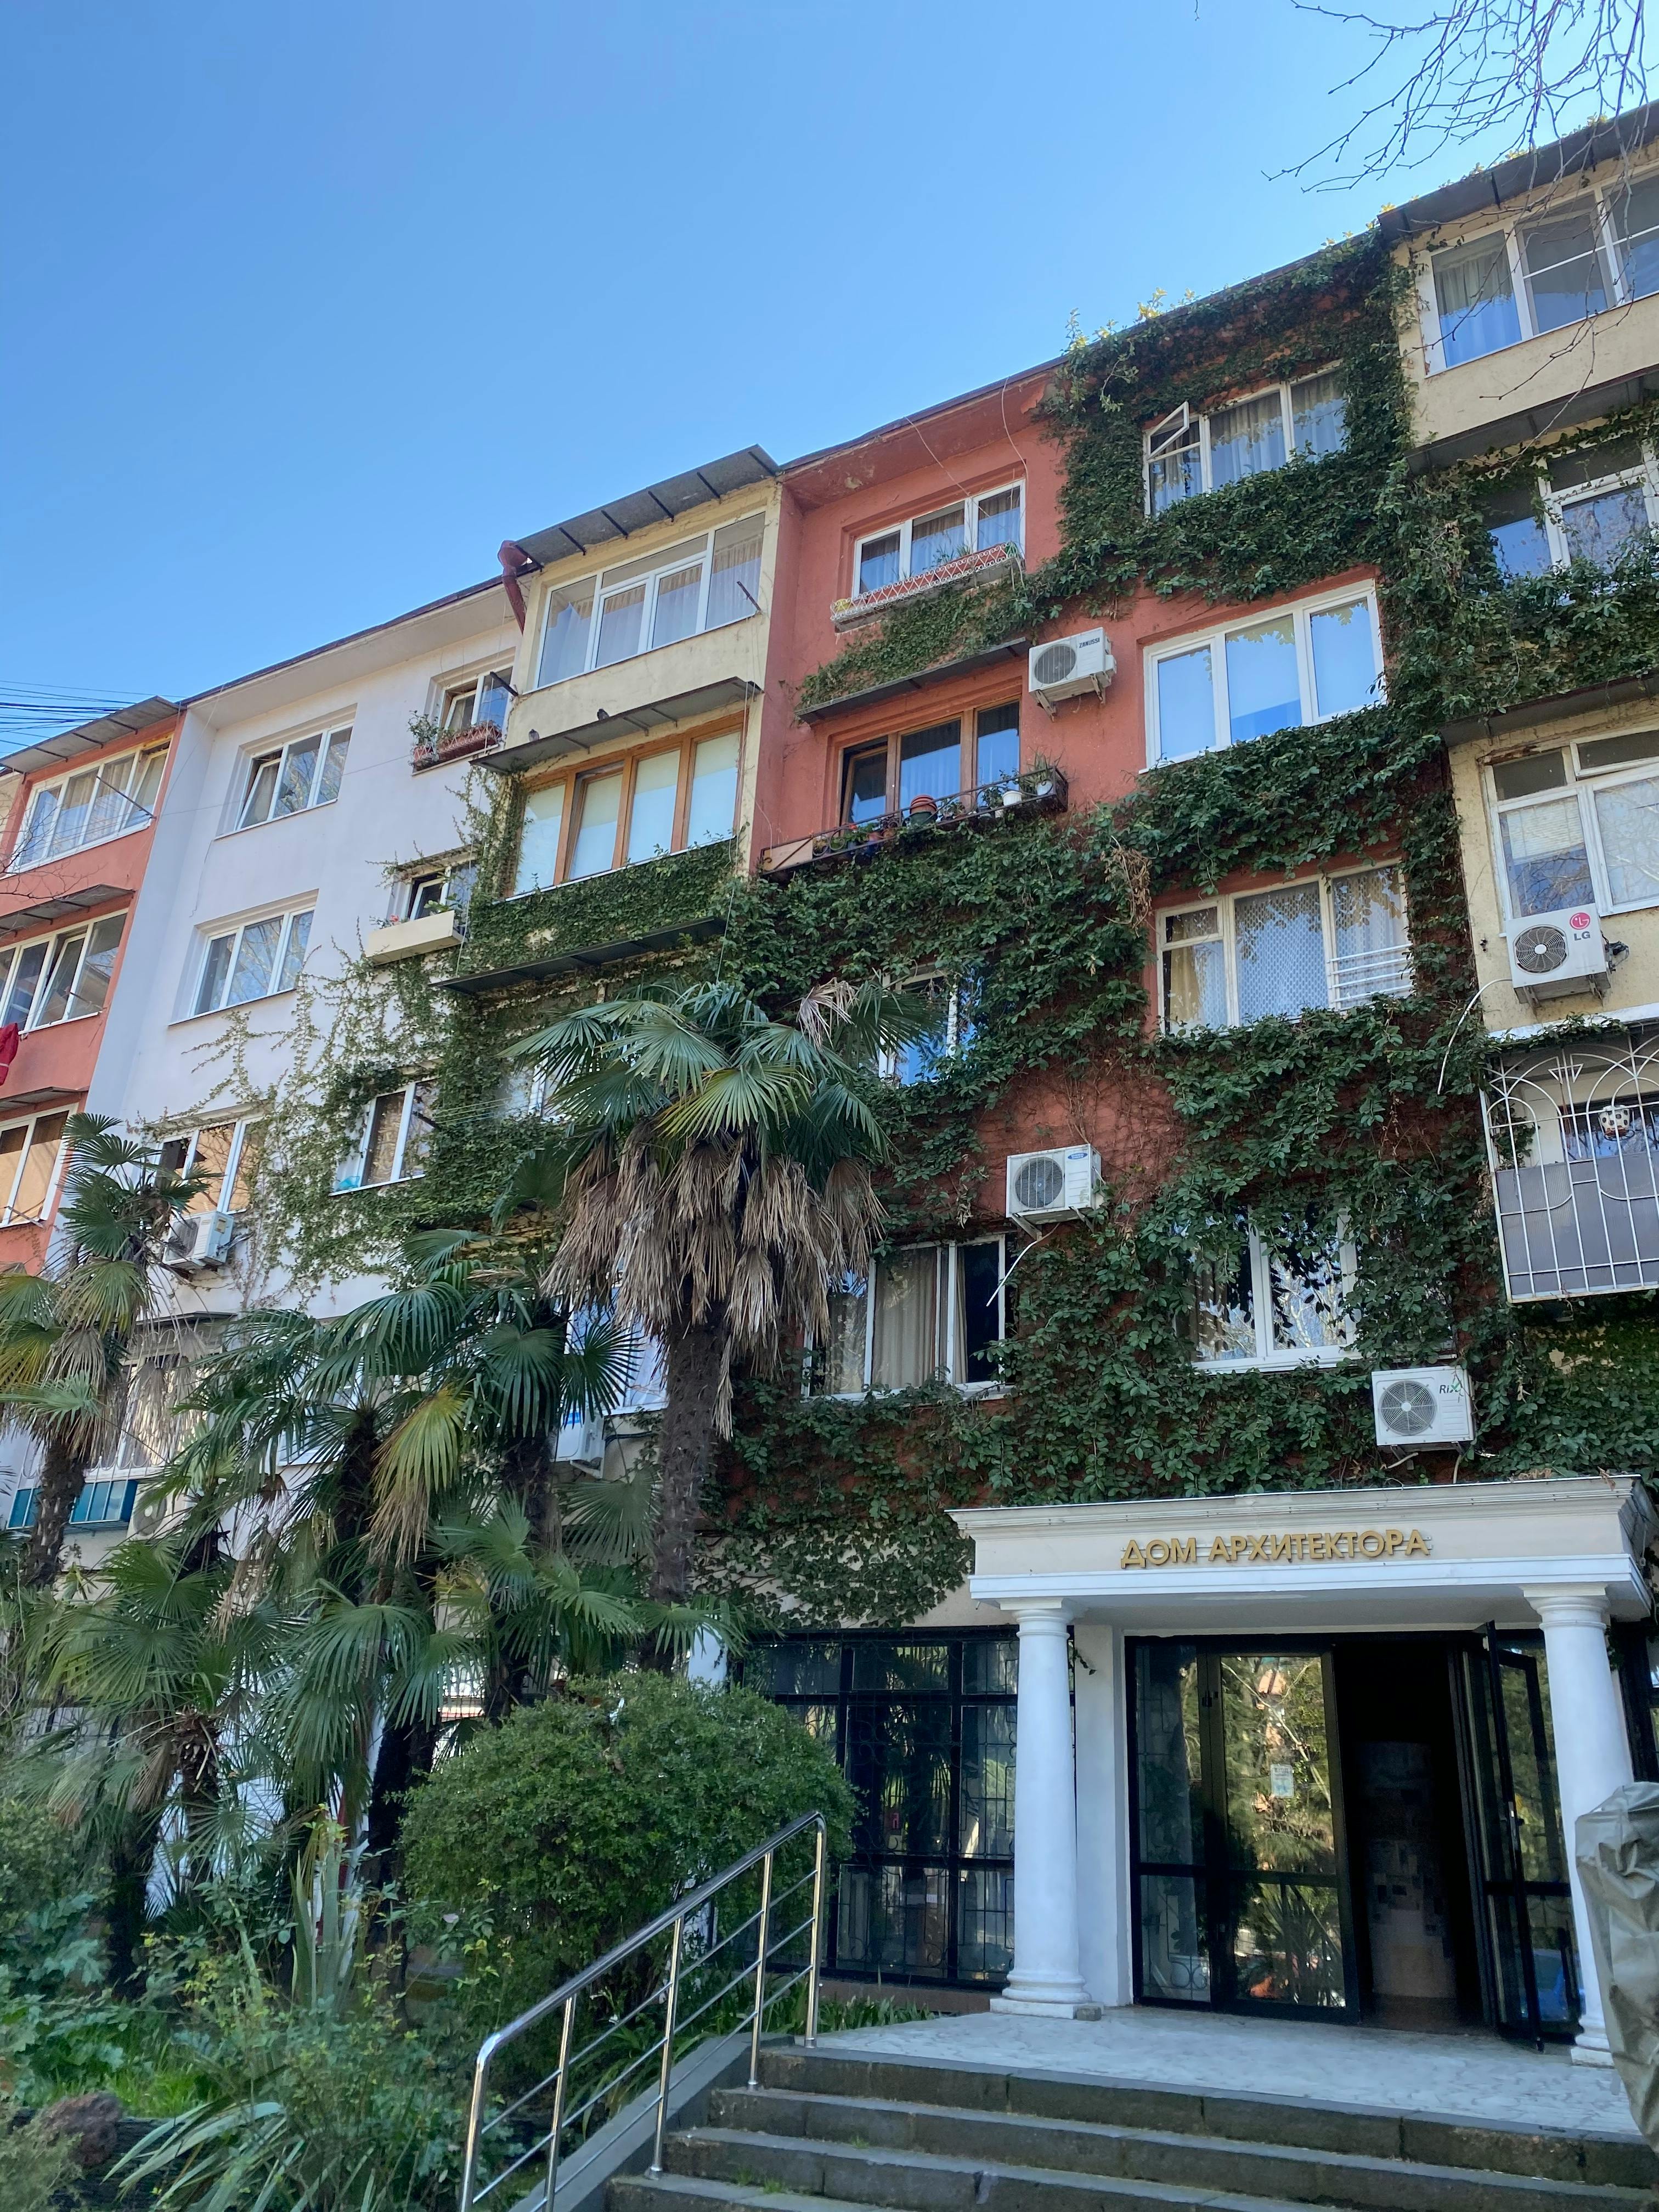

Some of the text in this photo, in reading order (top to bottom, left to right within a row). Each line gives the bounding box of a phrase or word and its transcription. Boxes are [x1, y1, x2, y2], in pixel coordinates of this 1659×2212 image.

[1079, 637, 1100, 648] ZANUSSI
[1574, 932, 1590, 940] LG
[1121, 1530, 1429, 1568] ДОМ АРХИТЕКТОРА
